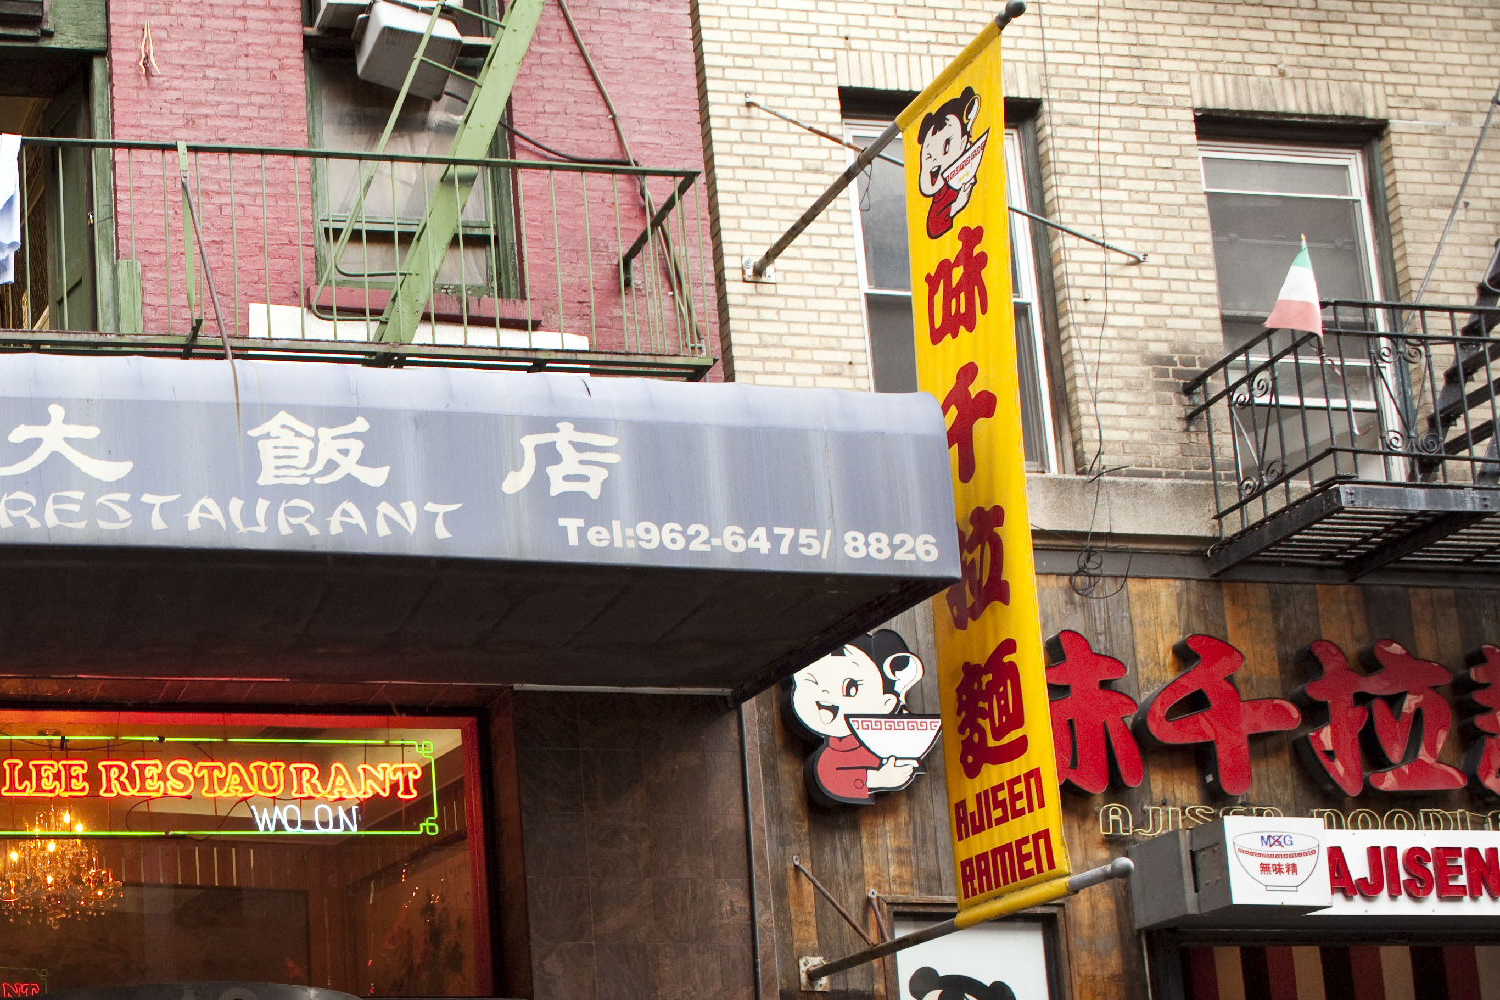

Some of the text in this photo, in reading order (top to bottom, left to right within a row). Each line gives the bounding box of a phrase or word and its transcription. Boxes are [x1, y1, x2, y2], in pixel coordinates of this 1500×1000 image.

[844, 530, 940, 564] 8826
[0, 759, 90, 798] LEE
[98, 759, 423, 800] RESTAURANT
[954, 766, 1046, 842] AJISEN
[959, 827, 1057, 900] RAMEN
[1259, 862, 1298, 876] 無味精
[1327, 846, 1500, 898] AJISEN
